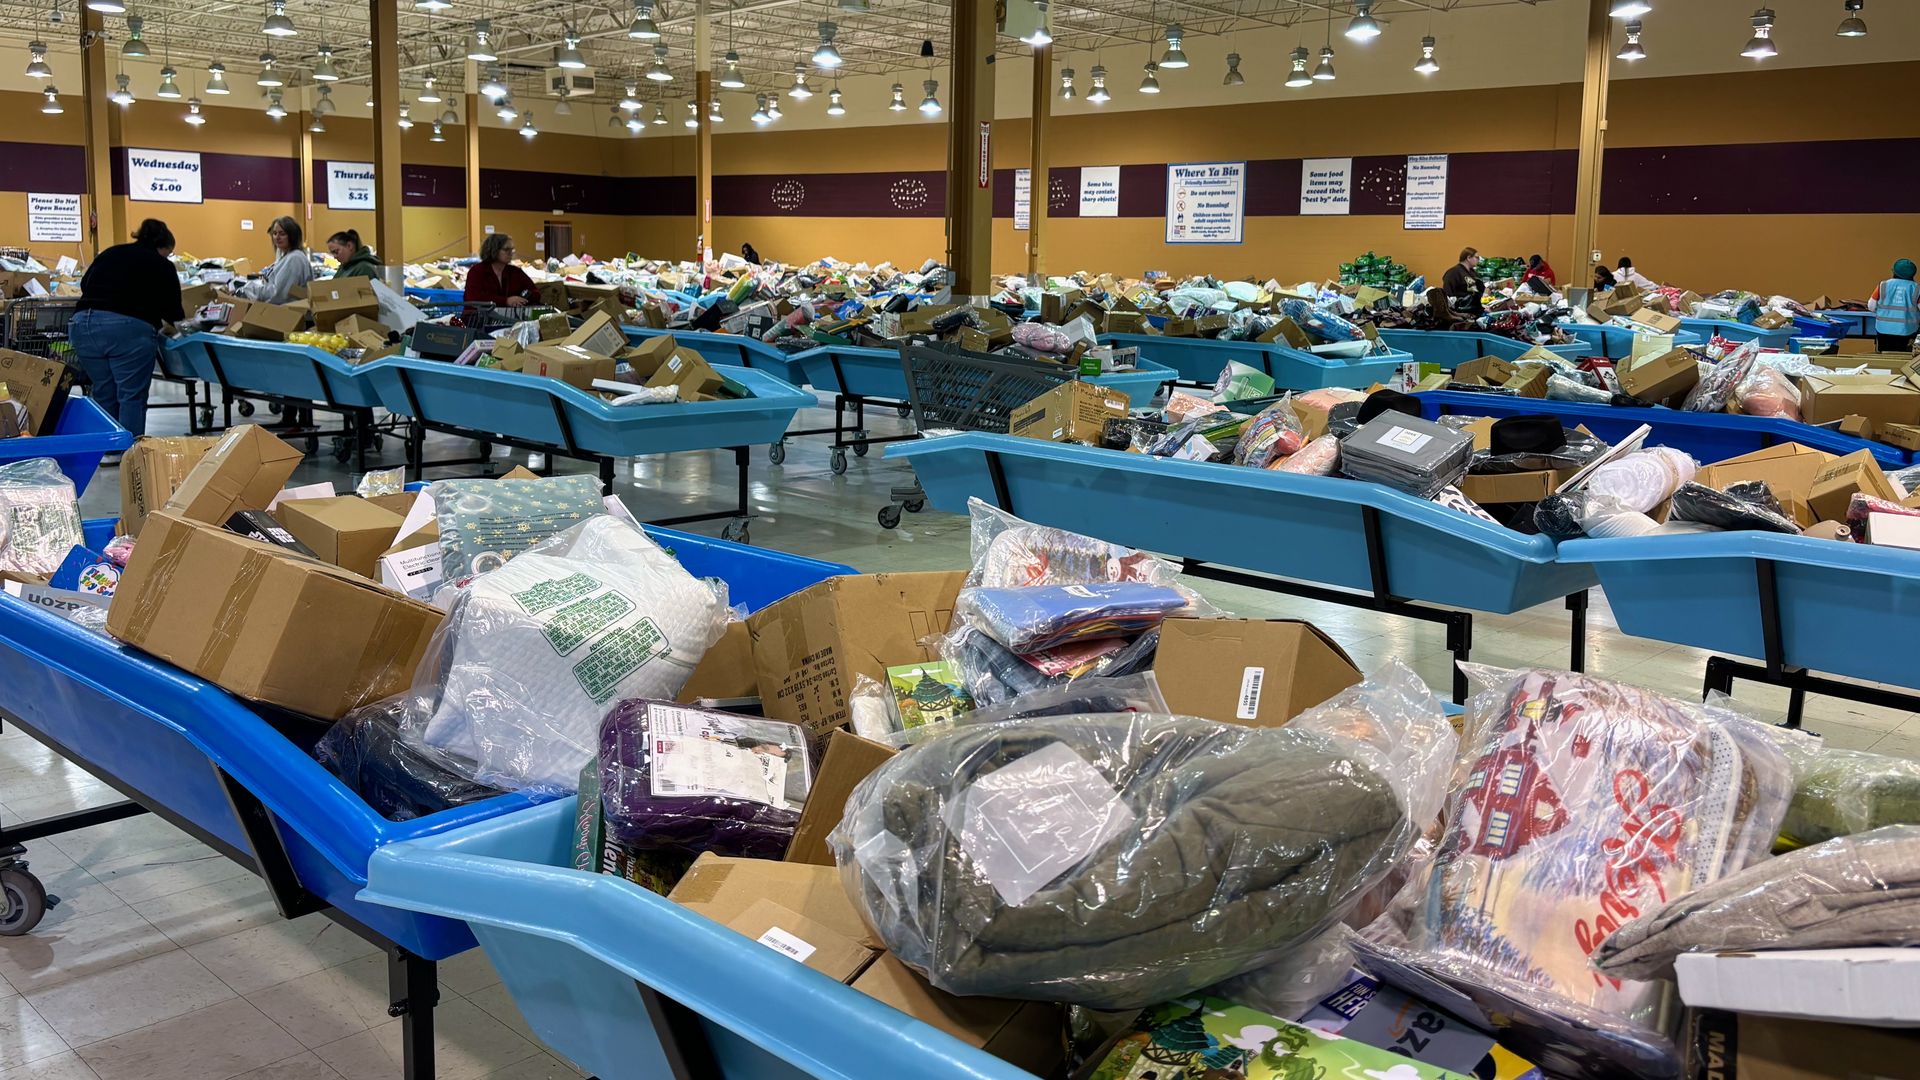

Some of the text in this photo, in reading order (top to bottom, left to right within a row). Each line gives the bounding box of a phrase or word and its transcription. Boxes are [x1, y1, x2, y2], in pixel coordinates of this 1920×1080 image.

[131, 157, 199, 172] Wednesday
[334, 170, 376, 179] Thursda
[1175, 167, 1239, 178] Where Ya Bin
[151, 183, 182, 192] $1.00
[348, 192, 368, 201] $.25
[403, 561, 425, 570] Electric
[80, 575, 98, 590] Toy
[86, 567, 116, 588] Fidget
[28, 593, 82, 611] azon
[822, 646, 832, 658] MADE
[803, 654, 814, 666] CHINA
[821, 656, 834, 669] Carton
[587, 662, 599, 674] BOLSA
[823, 667, 836, 679] Carton
[799, 702, 807, 712] KGS
[836, 709, 845, 720] ITEM
[1350, 983, 1367, 995] FUN
